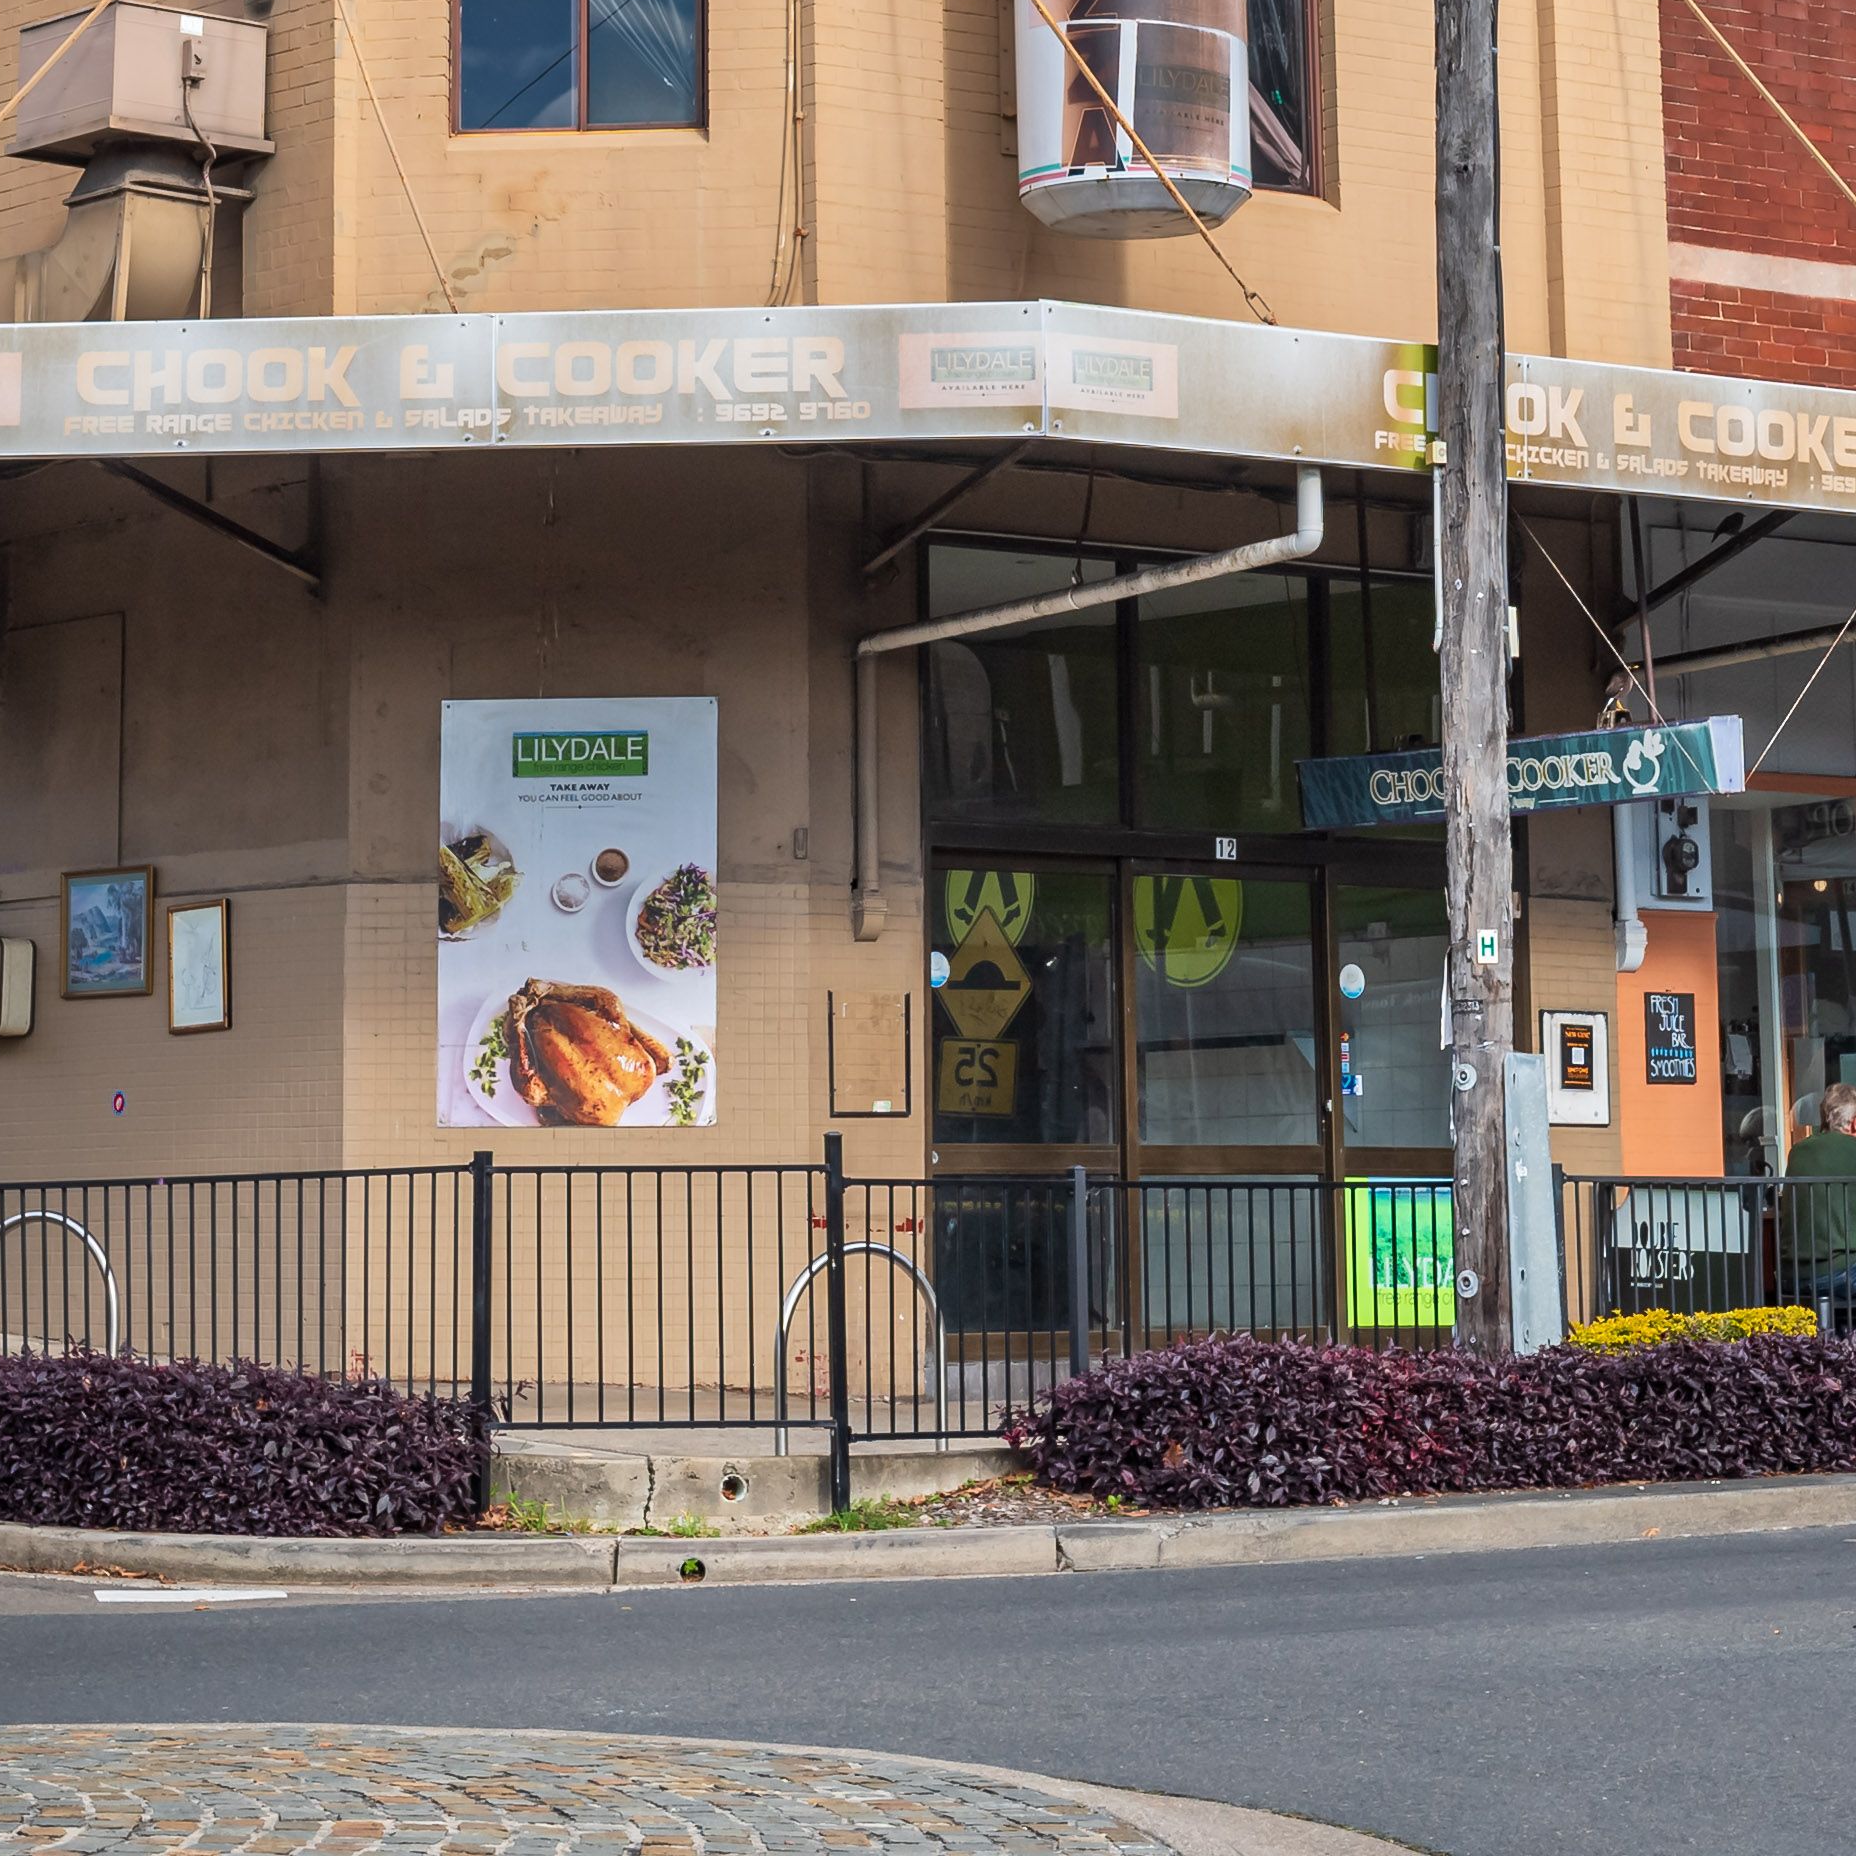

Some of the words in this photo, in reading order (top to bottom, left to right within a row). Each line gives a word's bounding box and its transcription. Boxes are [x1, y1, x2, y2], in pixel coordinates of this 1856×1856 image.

[1204, 115, 1225, 126] HERE
[935, 349, 1032, 371] LILYDALE
[1074, 355, 1150, 377] LILYDALE
[76, 344, 361, 412] CHOOK
[399, 344, 454, 400] &
[497, 335, 848, 401] COOKER
[1080, 387, 1124, 397] AVAILABLE
[63, 415, 135, 437] FREE
[145, 413, 233, 435] RANGE
[244, 410, 365, 432] CHICKEN
[375, 410, 392, 429] &
[404, 406, 511, 430] SALADS
[524, 402, 663, 427] TAKEAWAY
[715, 402, 788, 423] 9692
[799, 400, 872, 421] 9760
[1613, 393, 1652, 448] &
[1374, 429, 1427, 453] FREE
[1506, 443, 1589, 468] CHICKEN
[1596, 452, 1610, 470] &
[1616, 453, 1689, 478] SALADS
[1696, 459, 1788, 488] TAKEAWAY
[517, 736, 643, 762] LILYDALE
[518, 794, 537, 803] YOU
[538, 793, 559, 802] CAN
[560, 793, 580, 802] FEEL
[581, 793, 610, 802] GOOD
[612, 792, 643, 802] ABOUT
[550, 783, 577, 792] TAKE
[578, 782, 611, 792] AWAY
[1218, 838, 1236, 858] 12
[1481, 937, 1495, 958] H
[1650, 994, 1679, 1015] FRESH
[1659, 1014, 1685, 1032] JUICE
[1671, 1033, 1694, 1049] BAR
[1650, 1057, 1695, 1078] SMOOTHIES
